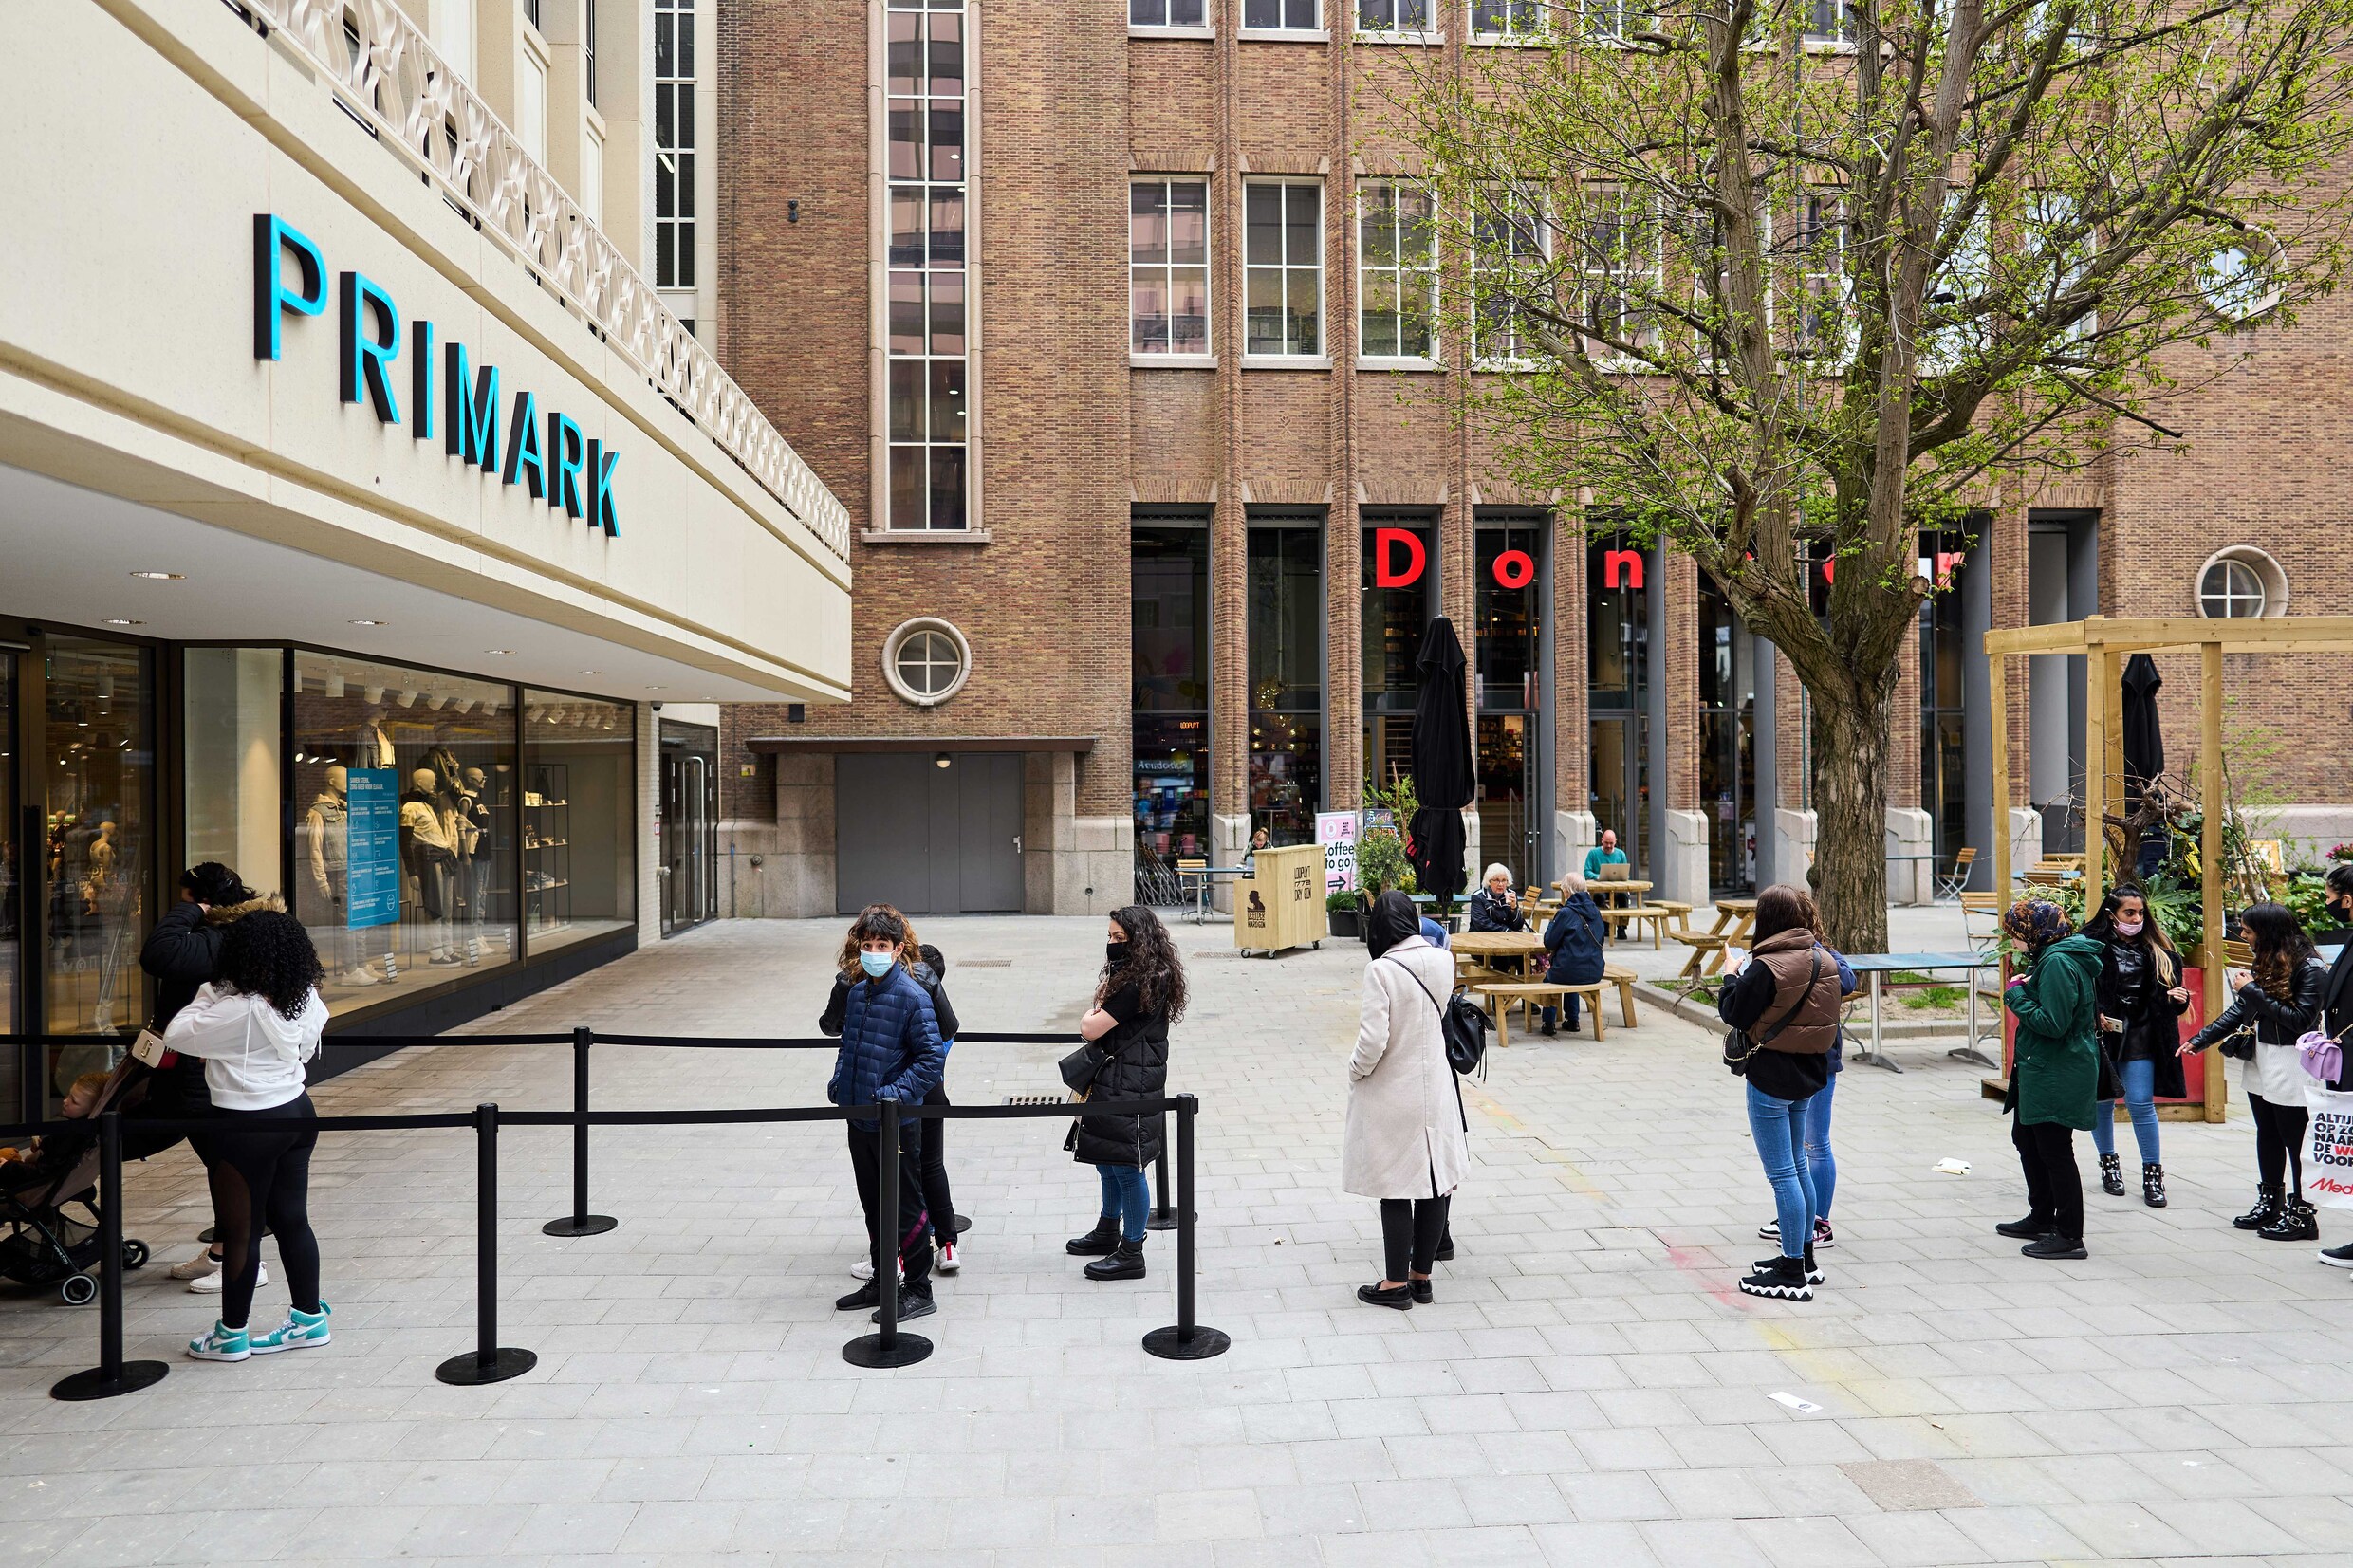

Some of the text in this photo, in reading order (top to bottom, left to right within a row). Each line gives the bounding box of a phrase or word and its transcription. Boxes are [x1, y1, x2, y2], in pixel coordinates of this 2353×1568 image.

[254, 213, 621, 537] PRIMARK
[1338, 858, 1350, 872] go
[2315, 1112, 2353, 1125] ALTIJ
[2314, 1122, 2336, 1133] OP
[2313, 1142, 2331, 1153] DE
